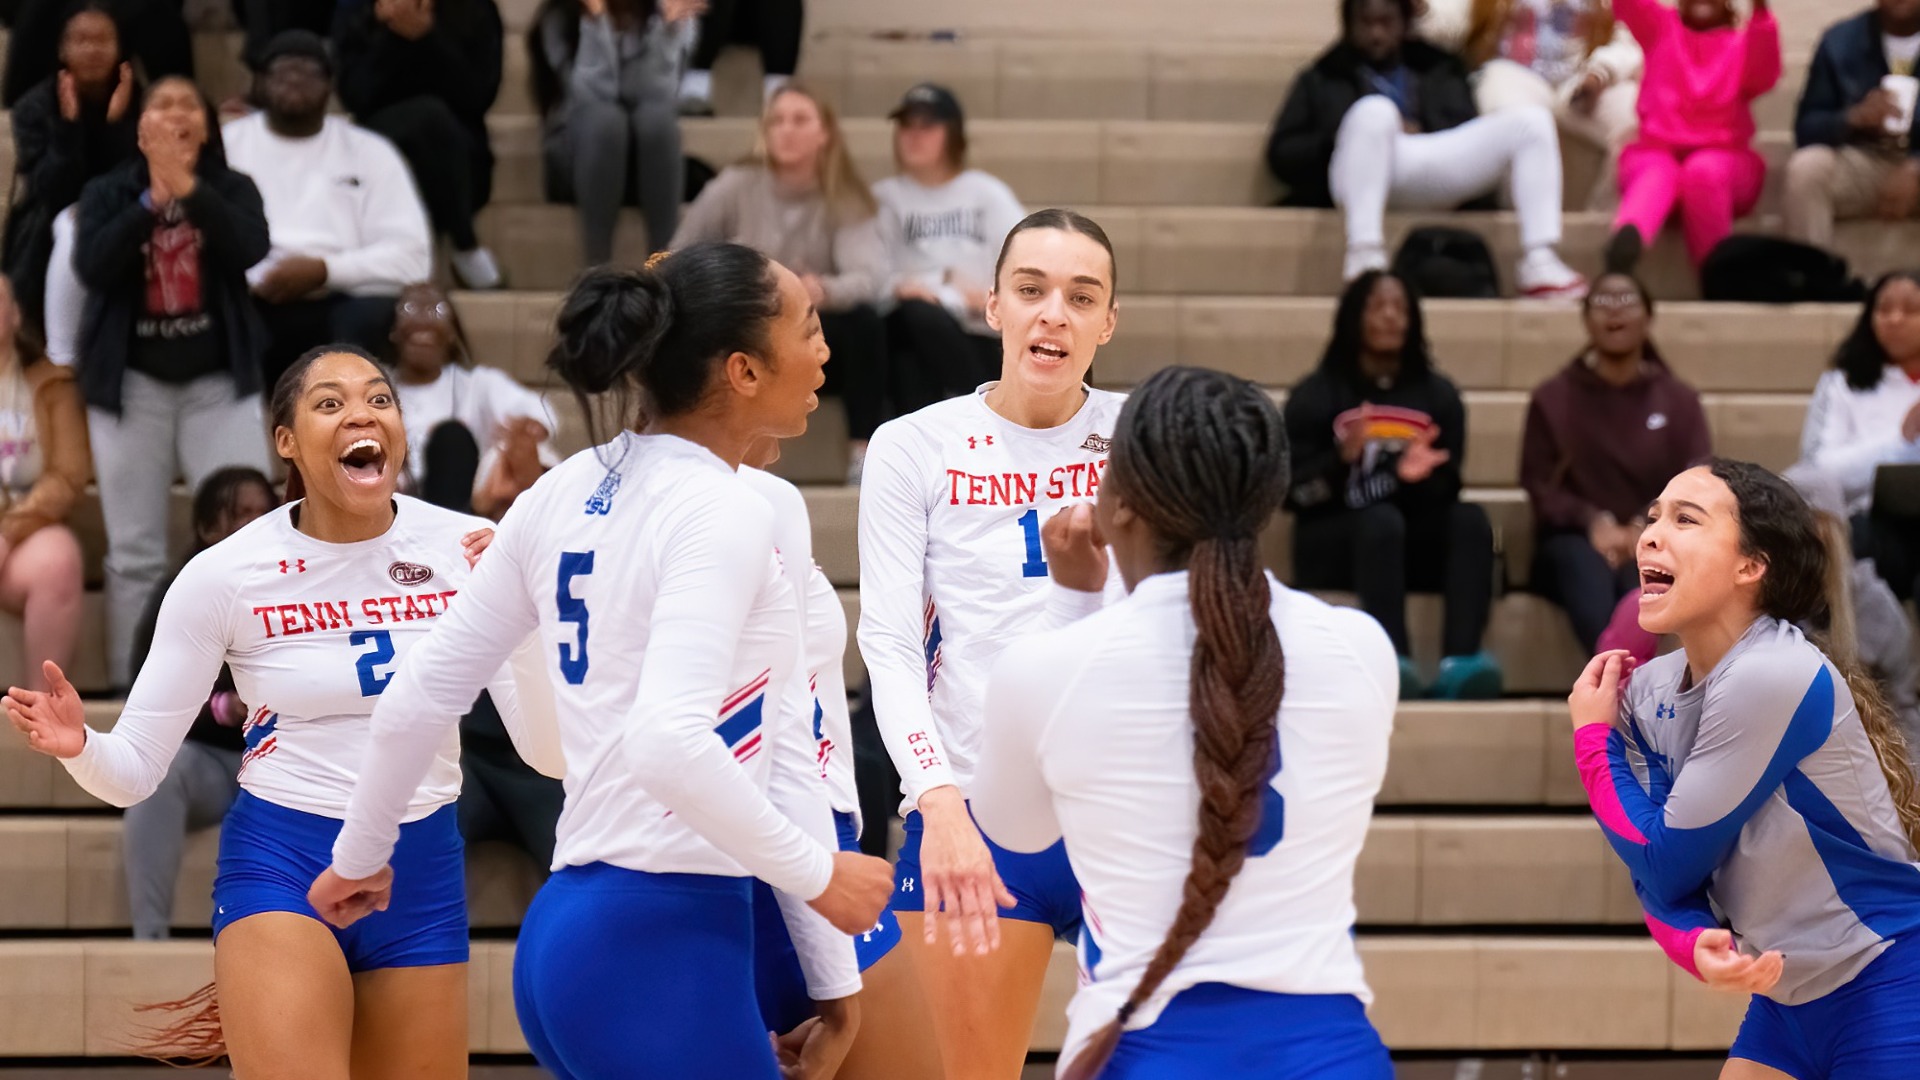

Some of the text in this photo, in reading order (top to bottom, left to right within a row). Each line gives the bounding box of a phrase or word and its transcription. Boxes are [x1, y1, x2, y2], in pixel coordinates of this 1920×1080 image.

[946, 459, 1109, 506] TENN STA
[1017, 509, 1048, 577] 1
[396, 568, 423, 580] OVC
[253, 601, 353, 638] TENN
[556, 550, 595, 685] 5
[349, 630, 396, 697] 2
